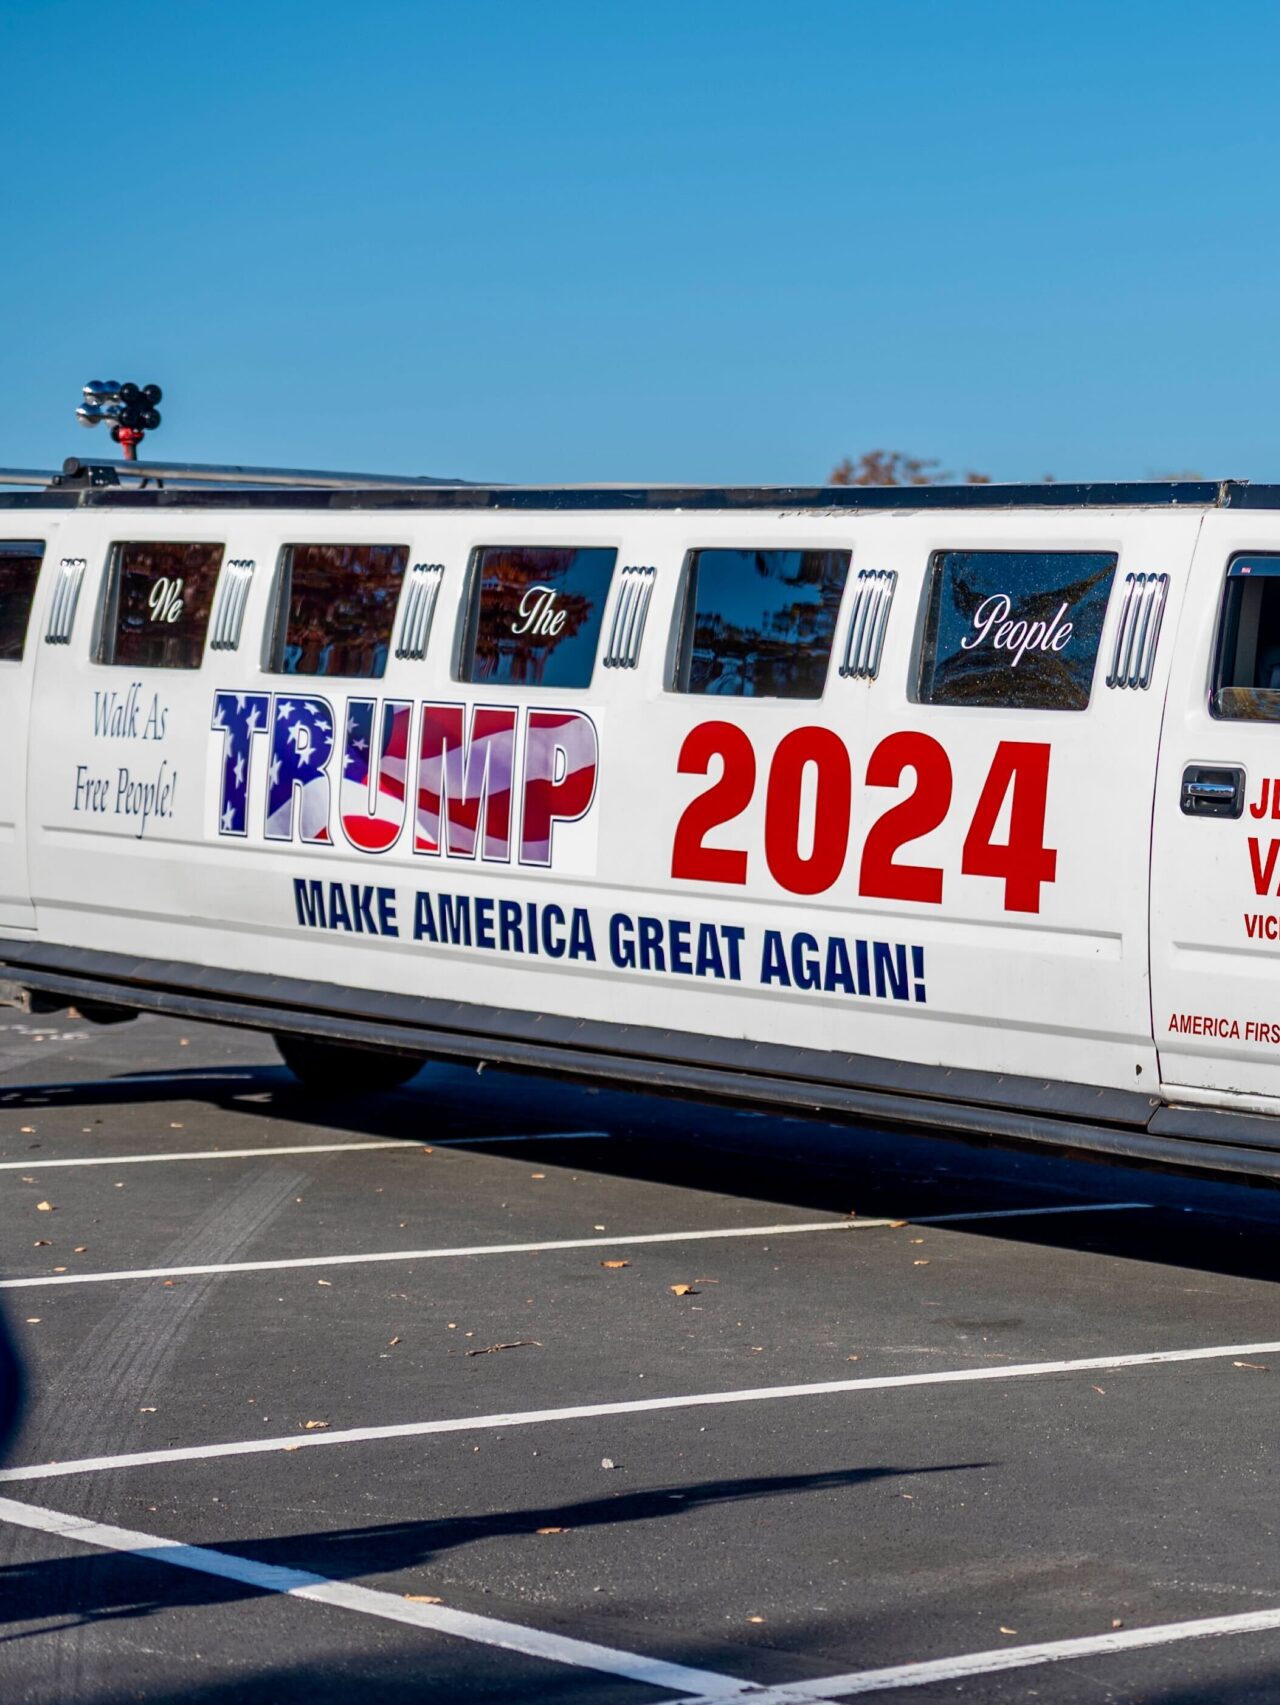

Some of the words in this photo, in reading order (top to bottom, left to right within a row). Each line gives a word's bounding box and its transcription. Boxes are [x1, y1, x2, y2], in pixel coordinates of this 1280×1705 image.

[148, 577, 182, 624] We
[511, 586, 565, 638] The
[961, 593, 1073, 667] People
[94, 682, 141, 738] Walk
[142, 692, 168, 740] As
[73, 765, 109, 812] Free
[114, 760, 177, 839] People!
[211, 688, 600, 868] TRUMP
[671, 720, 1057, 914] 2024
[293, 878, 400, 937] MAKE
[413, 891, 596, 962] AMERICA
[609, 912, 745, 980] GREAT
[760, 930, 926, 1003] AGAIN!
[1168, 1014, 1240, 1039] AMERICA
